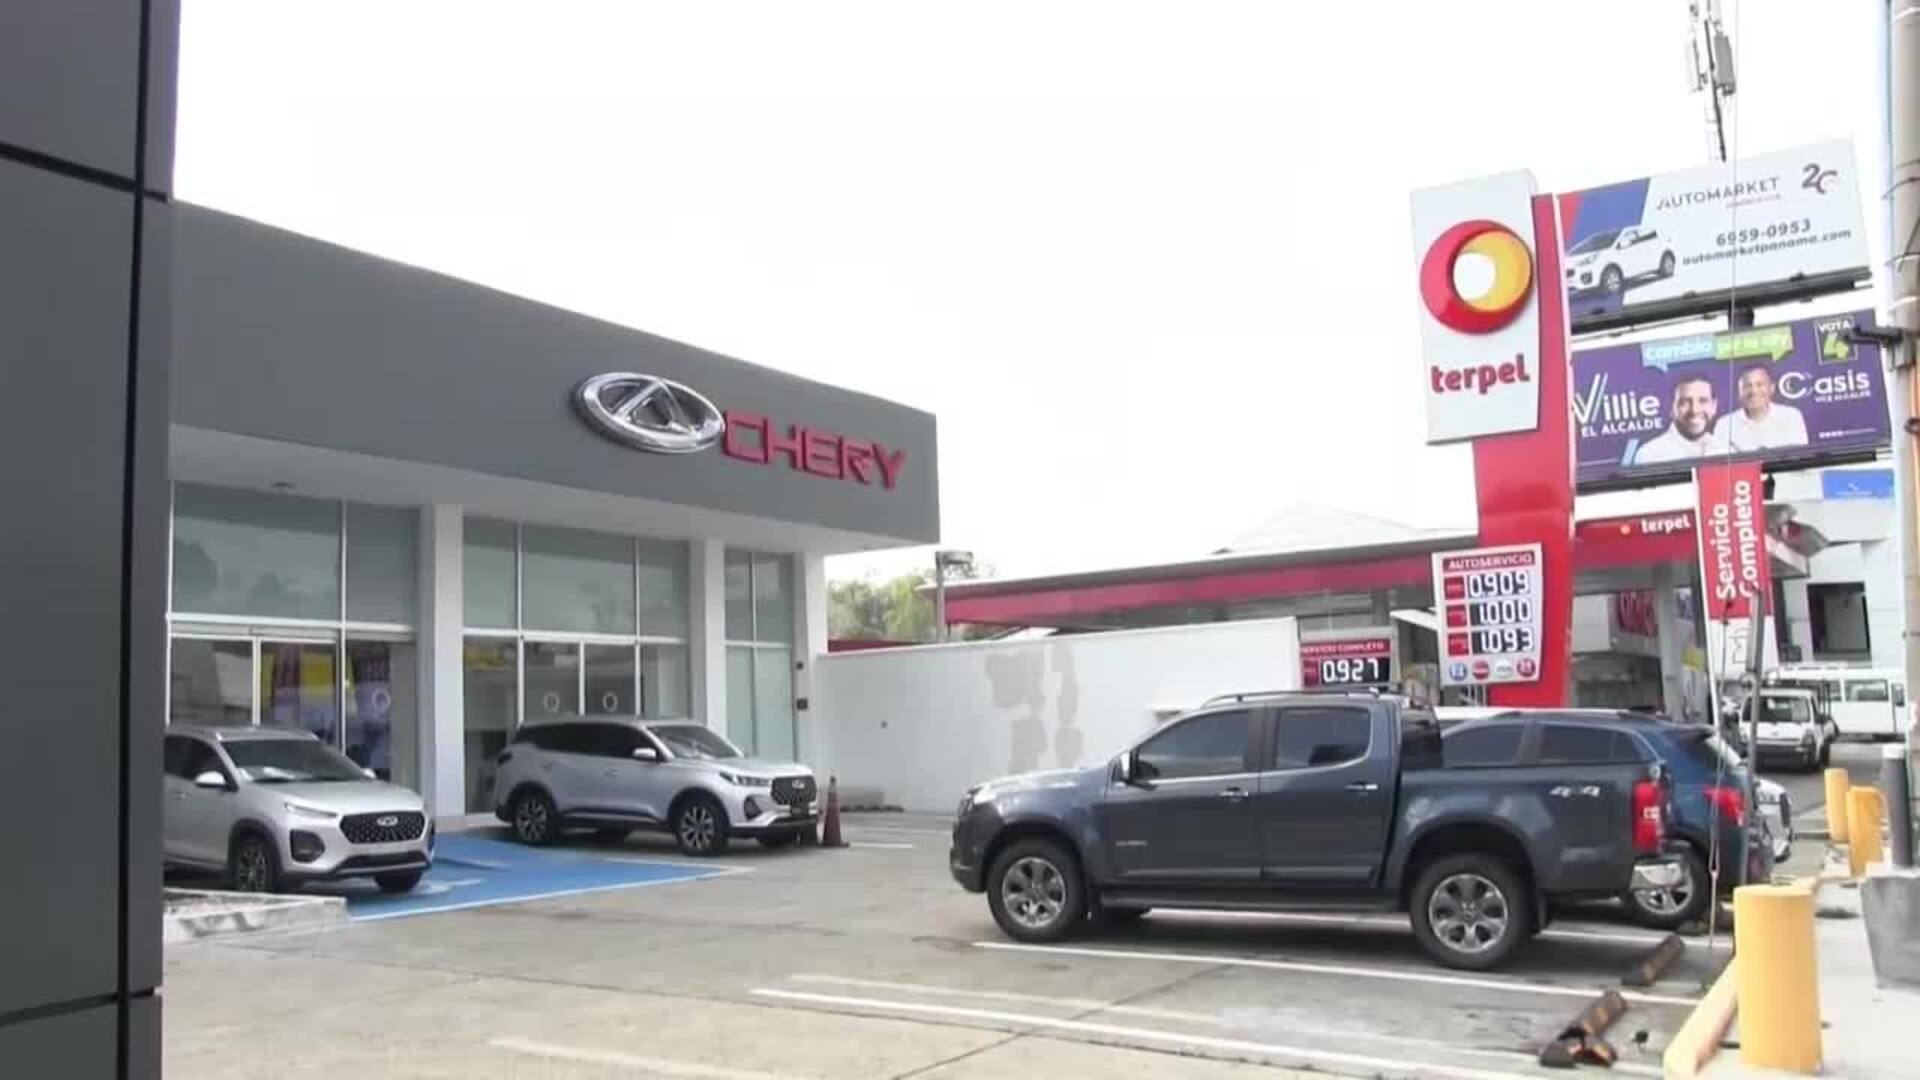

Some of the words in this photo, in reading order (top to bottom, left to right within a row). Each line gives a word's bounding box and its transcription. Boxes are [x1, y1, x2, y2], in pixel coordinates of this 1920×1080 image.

[1656, 177, 1780, 210] AUTOMARKET
[1682, 229, 1852, 265] automarketpanama.com
[1716, 218, 1811, 246] 6959-0953
[1818, 320, 1851, 333] VOTA
[1431, 354, 1530, 395] terpel
[1582, 426, 1598, 438] EL
[1602, 417, 1663, 435] ALCALDE
[722, 409, 907, 490] CHERY
[1641, 514, 1691, 534] terpel
[1733, 480, 1759, 598] Completo
[1448, 552, 1533, 570] AUTOSERVICIO
[1708, 504, 1737, 600] Servicio
